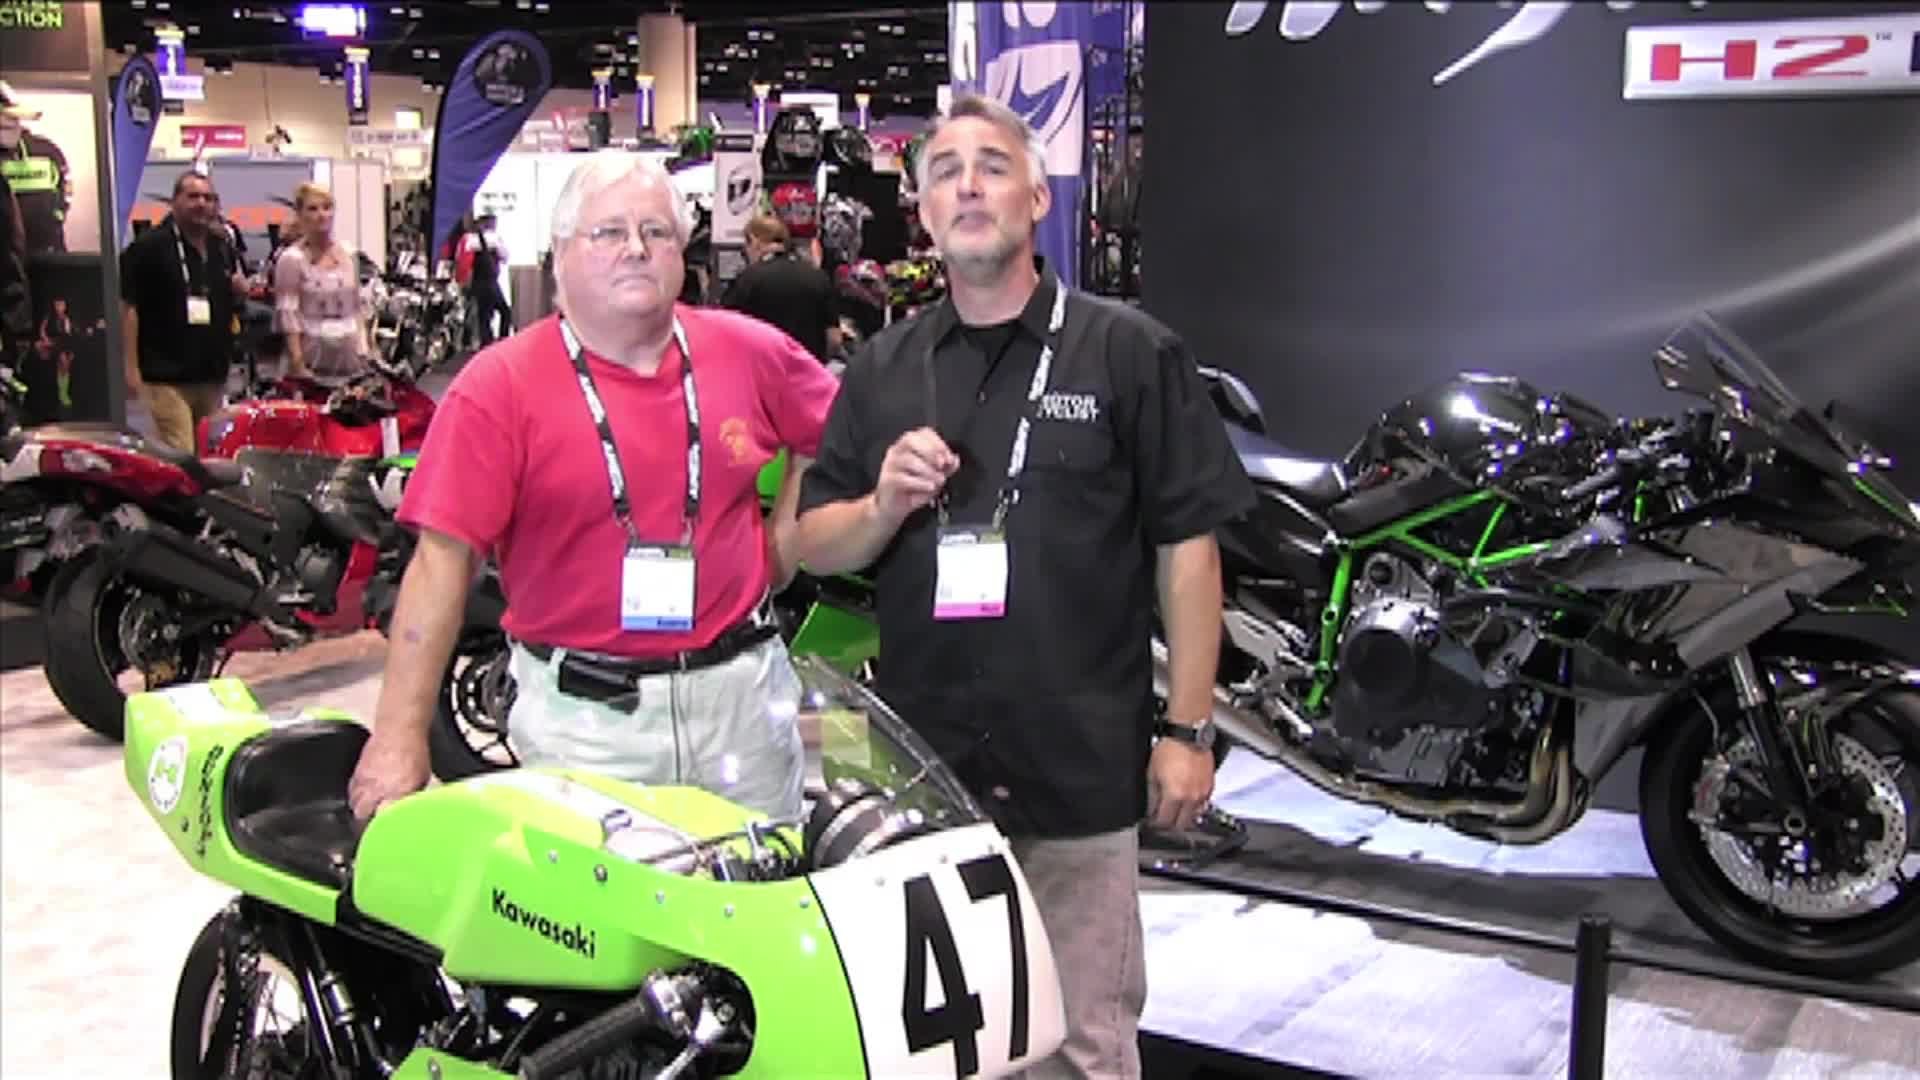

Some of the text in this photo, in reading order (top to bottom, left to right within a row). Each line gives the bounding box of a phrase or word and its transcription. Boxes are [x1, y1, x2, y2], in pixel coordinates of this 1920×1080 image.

[1650, 35, 1870, 81] H2
[492, 887, 595, 960] Kawasaki
[902, 854, 1030, 1080] 47
